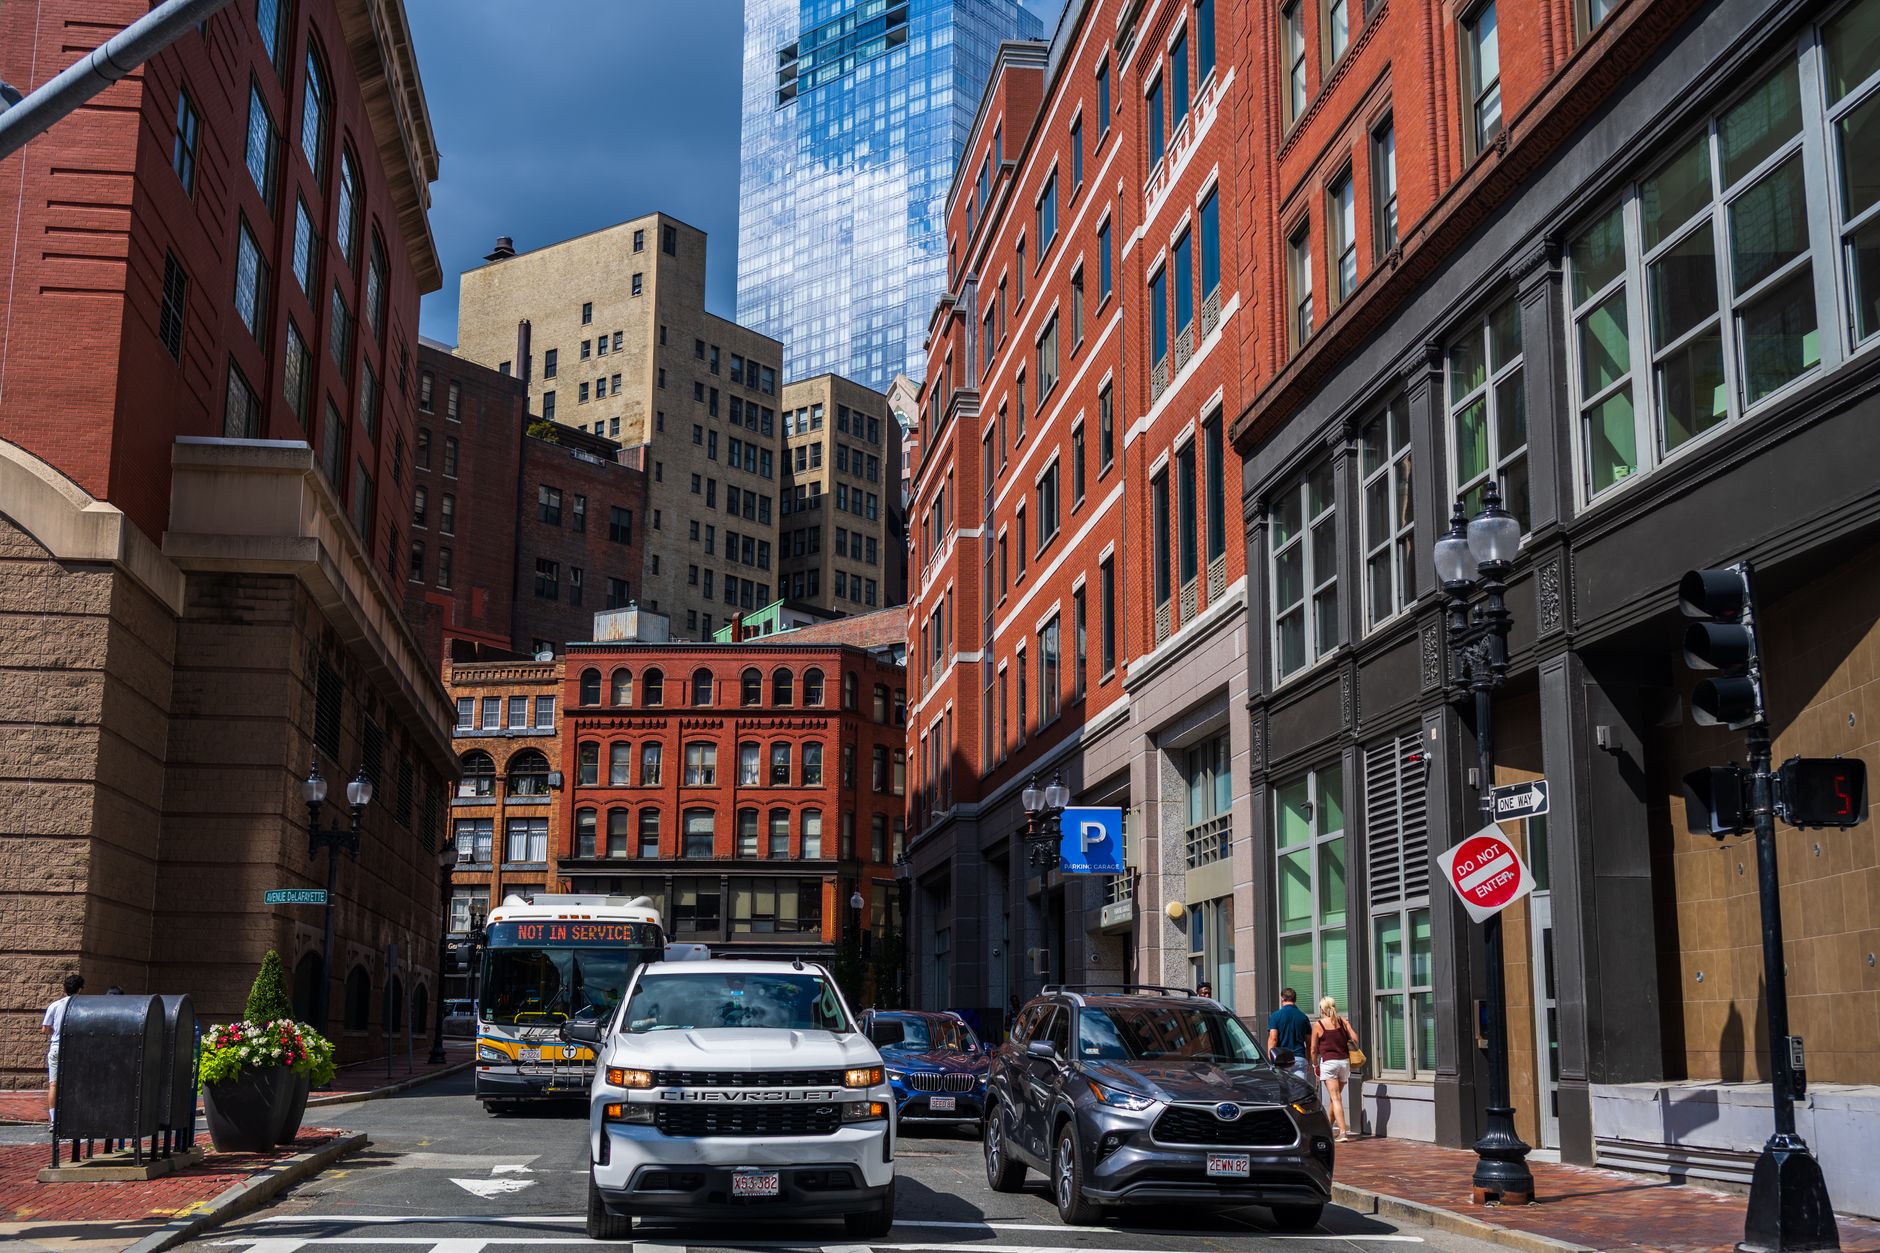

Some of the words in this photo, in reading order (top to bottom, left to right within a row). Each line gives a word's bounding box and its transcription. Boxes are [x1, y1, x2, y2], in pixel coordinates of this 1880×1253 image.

[1500, 797, 1514, 811] ONE
[1518, 793, 1532, 807] WAY
[1834, 776, 1851, 814] 5
[1081, 822, 1106, 852] P
[1456, 860, 1475, 877] DO
[1476, 844, 1500, 864] NOT
[1475, 870, 1513, 898] ENTER
[267, 892, 286, 902] AVENUE
[517, 924, 544, 940] NOT
[549, 924, 566, 940] IN
[571, 924, 632, 940] SERVICE
[660, 1091, 841, 1102] CHEVROLET
[1235, 1159, 1248, 1172] 82
